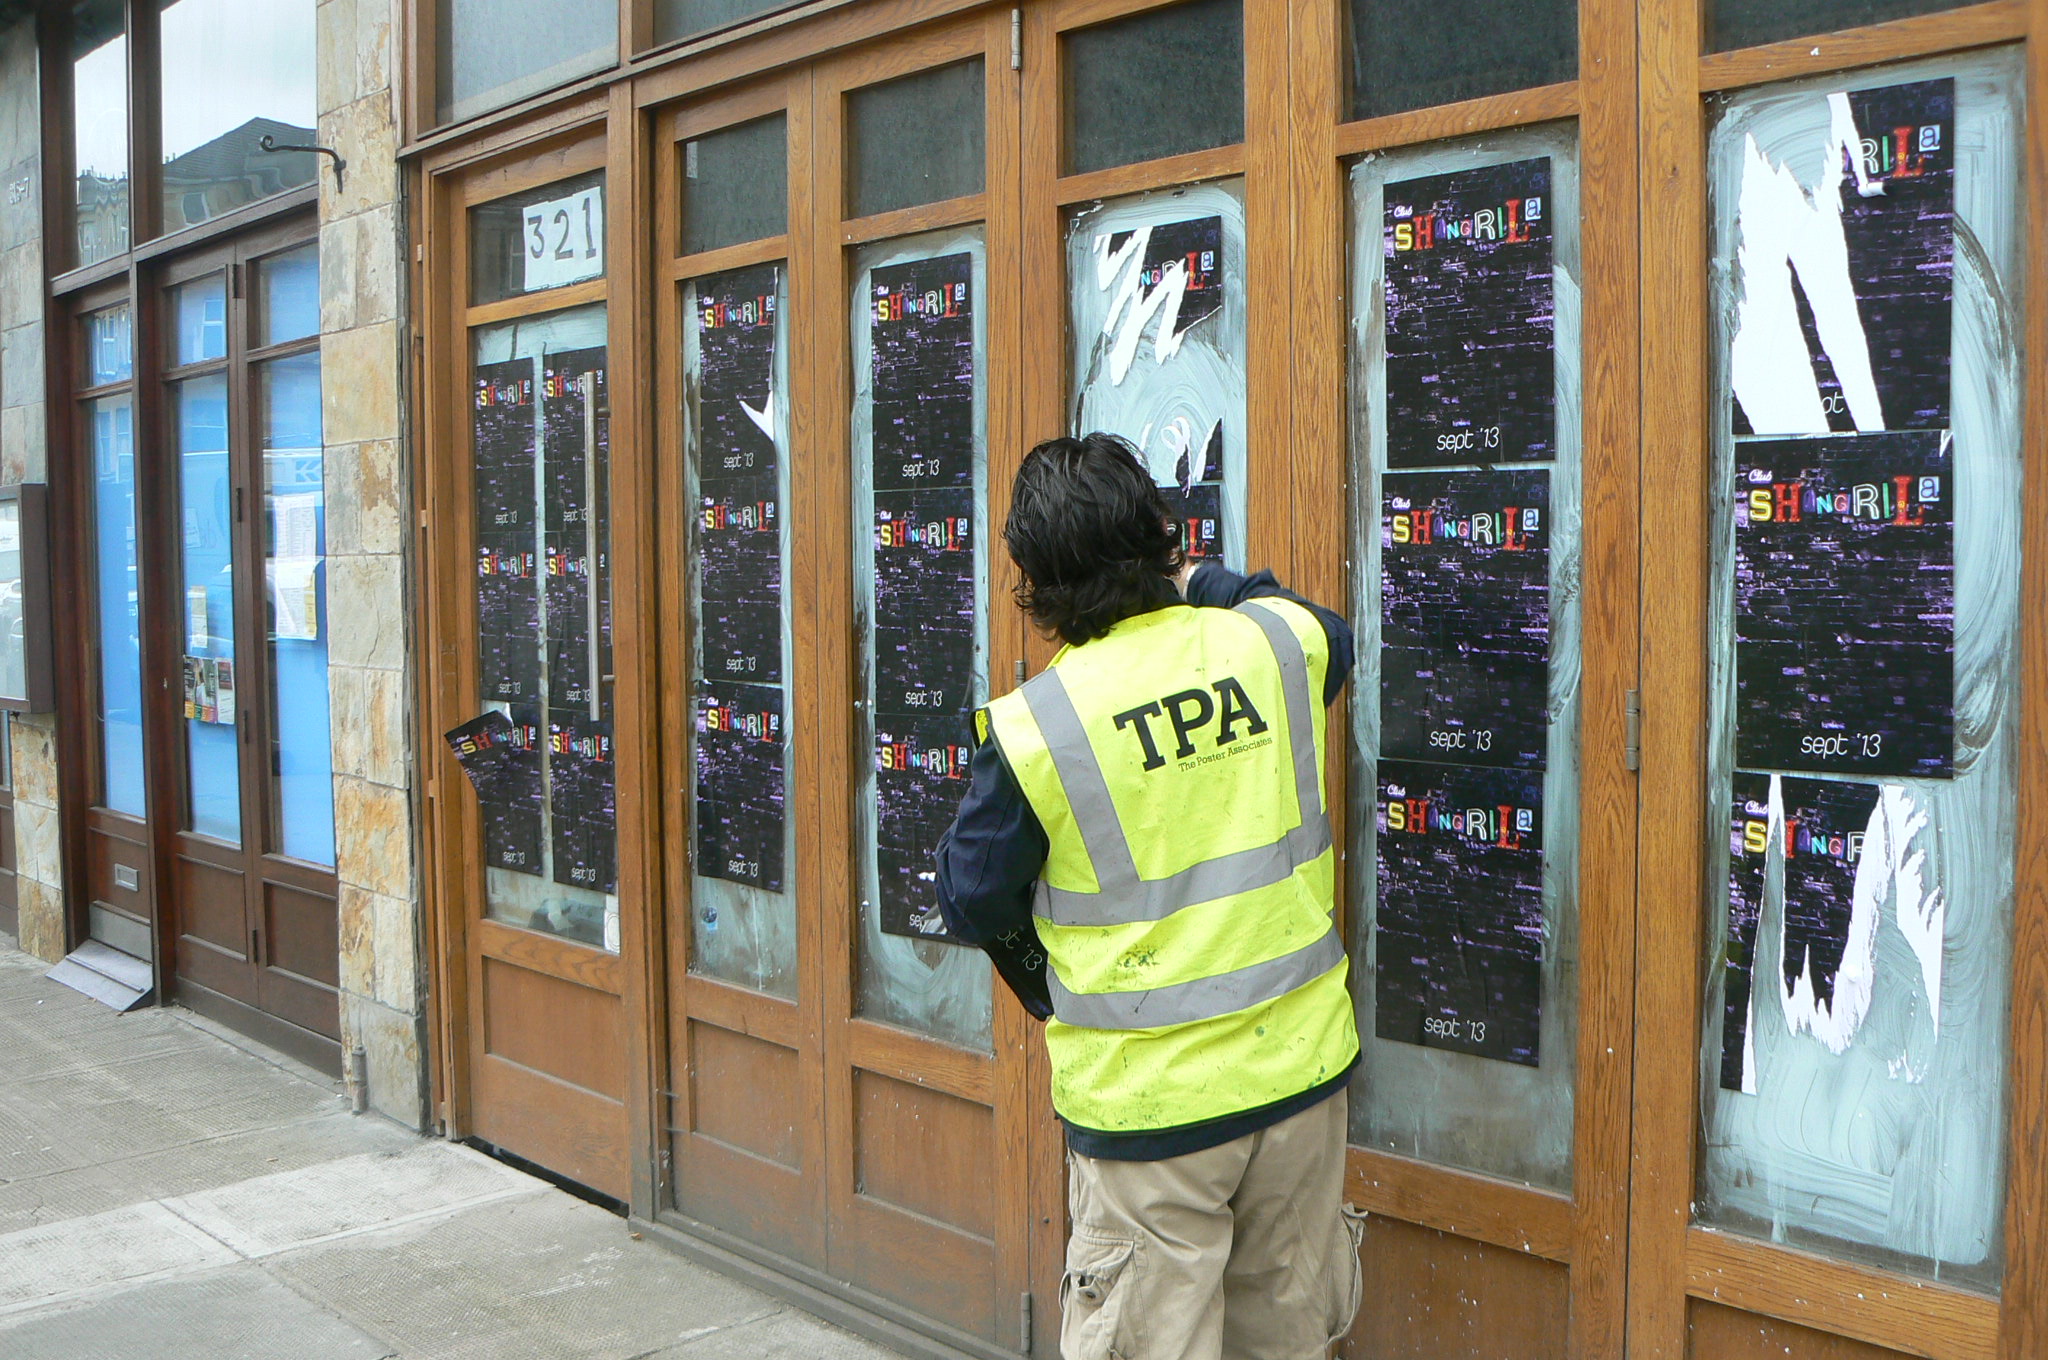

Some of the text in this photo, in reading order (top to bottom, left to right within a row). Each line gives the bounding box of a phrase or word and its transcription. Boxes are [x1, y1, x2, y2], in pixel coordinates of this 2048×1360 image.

[1394, 204, 1413, 218] Club
[527, 196, 597, 260] 321
[1437, 426, 1500, 454] sept '13
[902, 460, 925, 479] sept
[1749, 469, 1773, 484] Club
[905, 690, 928, 708] sept
[1112, 676, 1269, 772] TPA
[1428, 729, 1492, 752] sept '13
[1801, 733, 1881, 759] sept '13
[1178, 737, 1273, 772] The Poster Associates
[1424, 1017, 1486, 1042] sept '13
